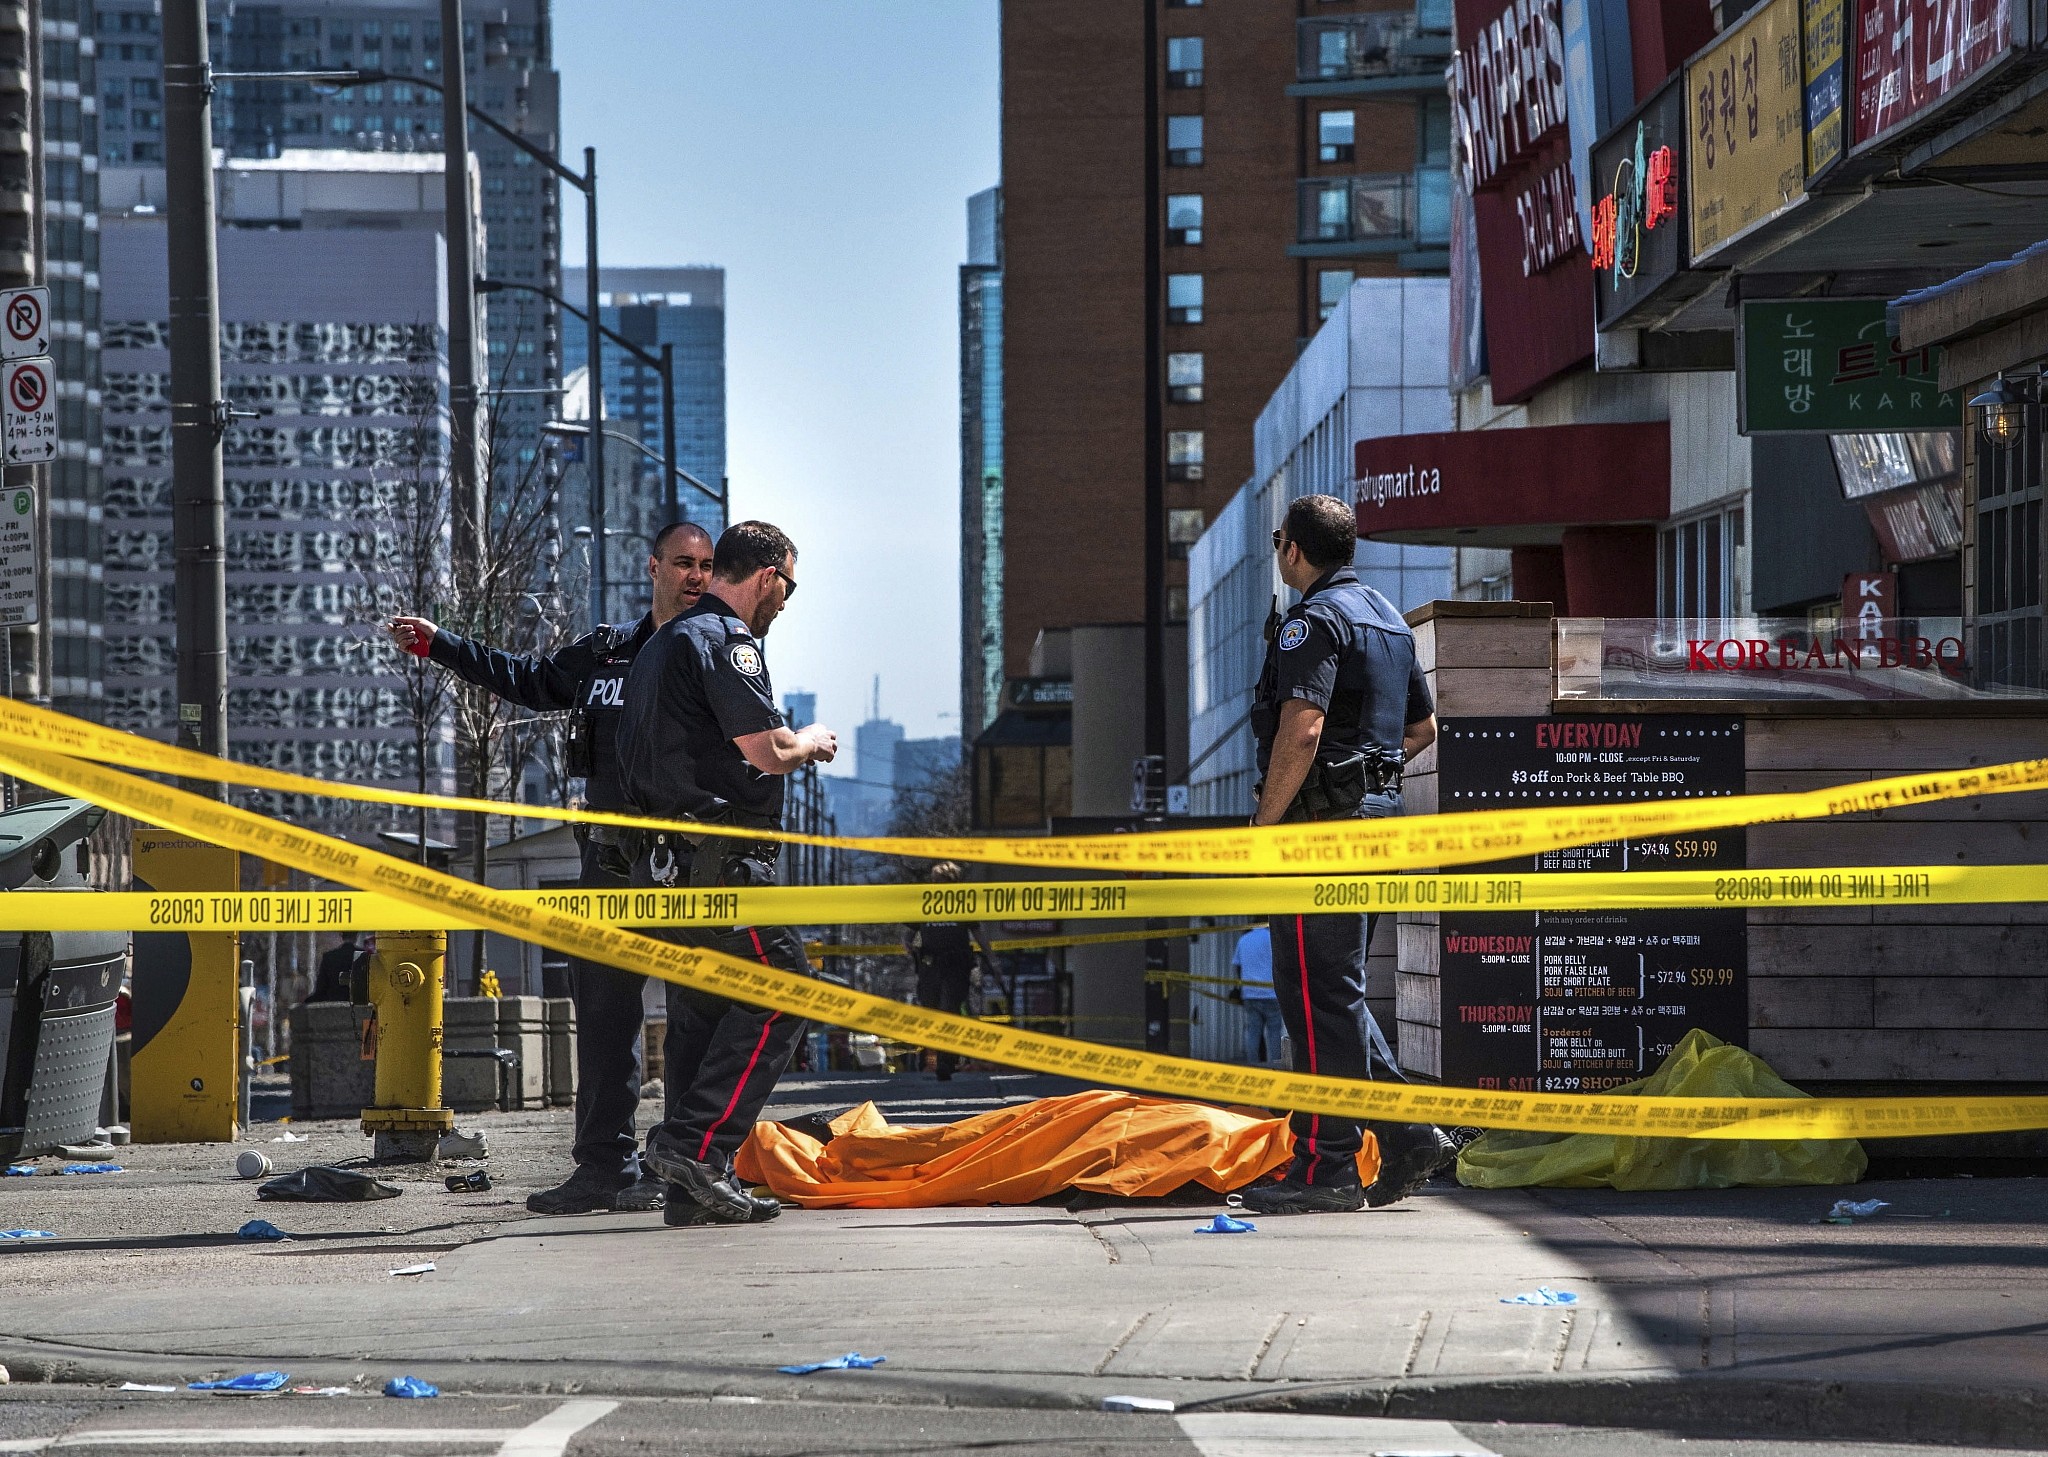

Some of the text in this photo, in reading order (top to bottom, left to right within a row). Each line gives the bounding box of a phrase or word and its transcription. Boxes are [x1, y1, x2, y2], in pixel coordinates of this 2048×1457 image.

[1516, 176, 1556, 278] DRUG
[1783, 313, 1816, 413] 노래방
[7, 412, 54, 426] 7 AM 9 AM
[8, 424, 54, 439] 4 PM 6 PM
[6, 521, 19, 530] FRI
[2, 544, 31, 553] 10:00PM
[4, 567, 32, 576] 10:00PM
[4, 590, 33, 600] 10:00PM
[1686, 636, 1967, 677] KOREAN BBQ
[587, 677, 625, 706] POL
[1536, 723, 1642, 748] EVERYDAY
[1556, 753, 1577, 762] 10:00
[1579, 753, 1592, 762] PM
[1600, 752, 1624, 762] CLOSE
[1670, 755, 1700, 763] Saturday
[1512, 770, 1685, 784] $3 off on Pork & Beef Table BBQ
[1828, 791, 1892, 815] POLICE
[1562, 848, 1585, 858] SHORT
[1587, 848, 1610, 858] PLATE
[1641, 843, 1670, 856] $74.96
[1674, 840, 1718, 859] $59.99
[1543, 860, 1592, 869] BEEF RIB EYE
[1544, 916, 1560, 924] with
[1575, 916, 1597, 924] order
[1598, 916, 1604, 924] of
[1604, 915, 1628, 924] drinks
[1446, 936, 1532, 954] WEDNESDAY
[1646, 936, 1659, 946] 소주
[1661, 938, 1670, 946] or
[1482, 955, 1586, 965] 5:00PM CLOSE PORK BELLY
[1544, 966, 1734, 986] PORK FALSE LEAN $72.96 $59.99
[1544, 977, 1611, 986] BEEF SHORT PLATE
[1544, 988, 1636, 997] SOJU OR PITCHER OF BEER
[1459, 1005, 1533, 1023] THURSDAY
[1566, 1008, 1576, 1016] or
[1631, 1006, 1644, 1016] 소주
[1646, 1008, 1656, 1016] or
[1482, 1024, 1593, 1037] 5:00PM CLOSE 3 orders of
[1550, 1038, 1569, 1047] PORK
[1571, 1038, 1592, 1047] BELLY
[1594, 1039, 1603, 1047] OR
[1550, 1048, 1626, 1058] PORK SHOULDER BUTT
[1543, 1060, 1634, 1069] SOJU OR PITCHER OF BEER
[1508, 1077, 1534, 1091] SAT
[1545, 1076, 1580, 1090] $2.99
